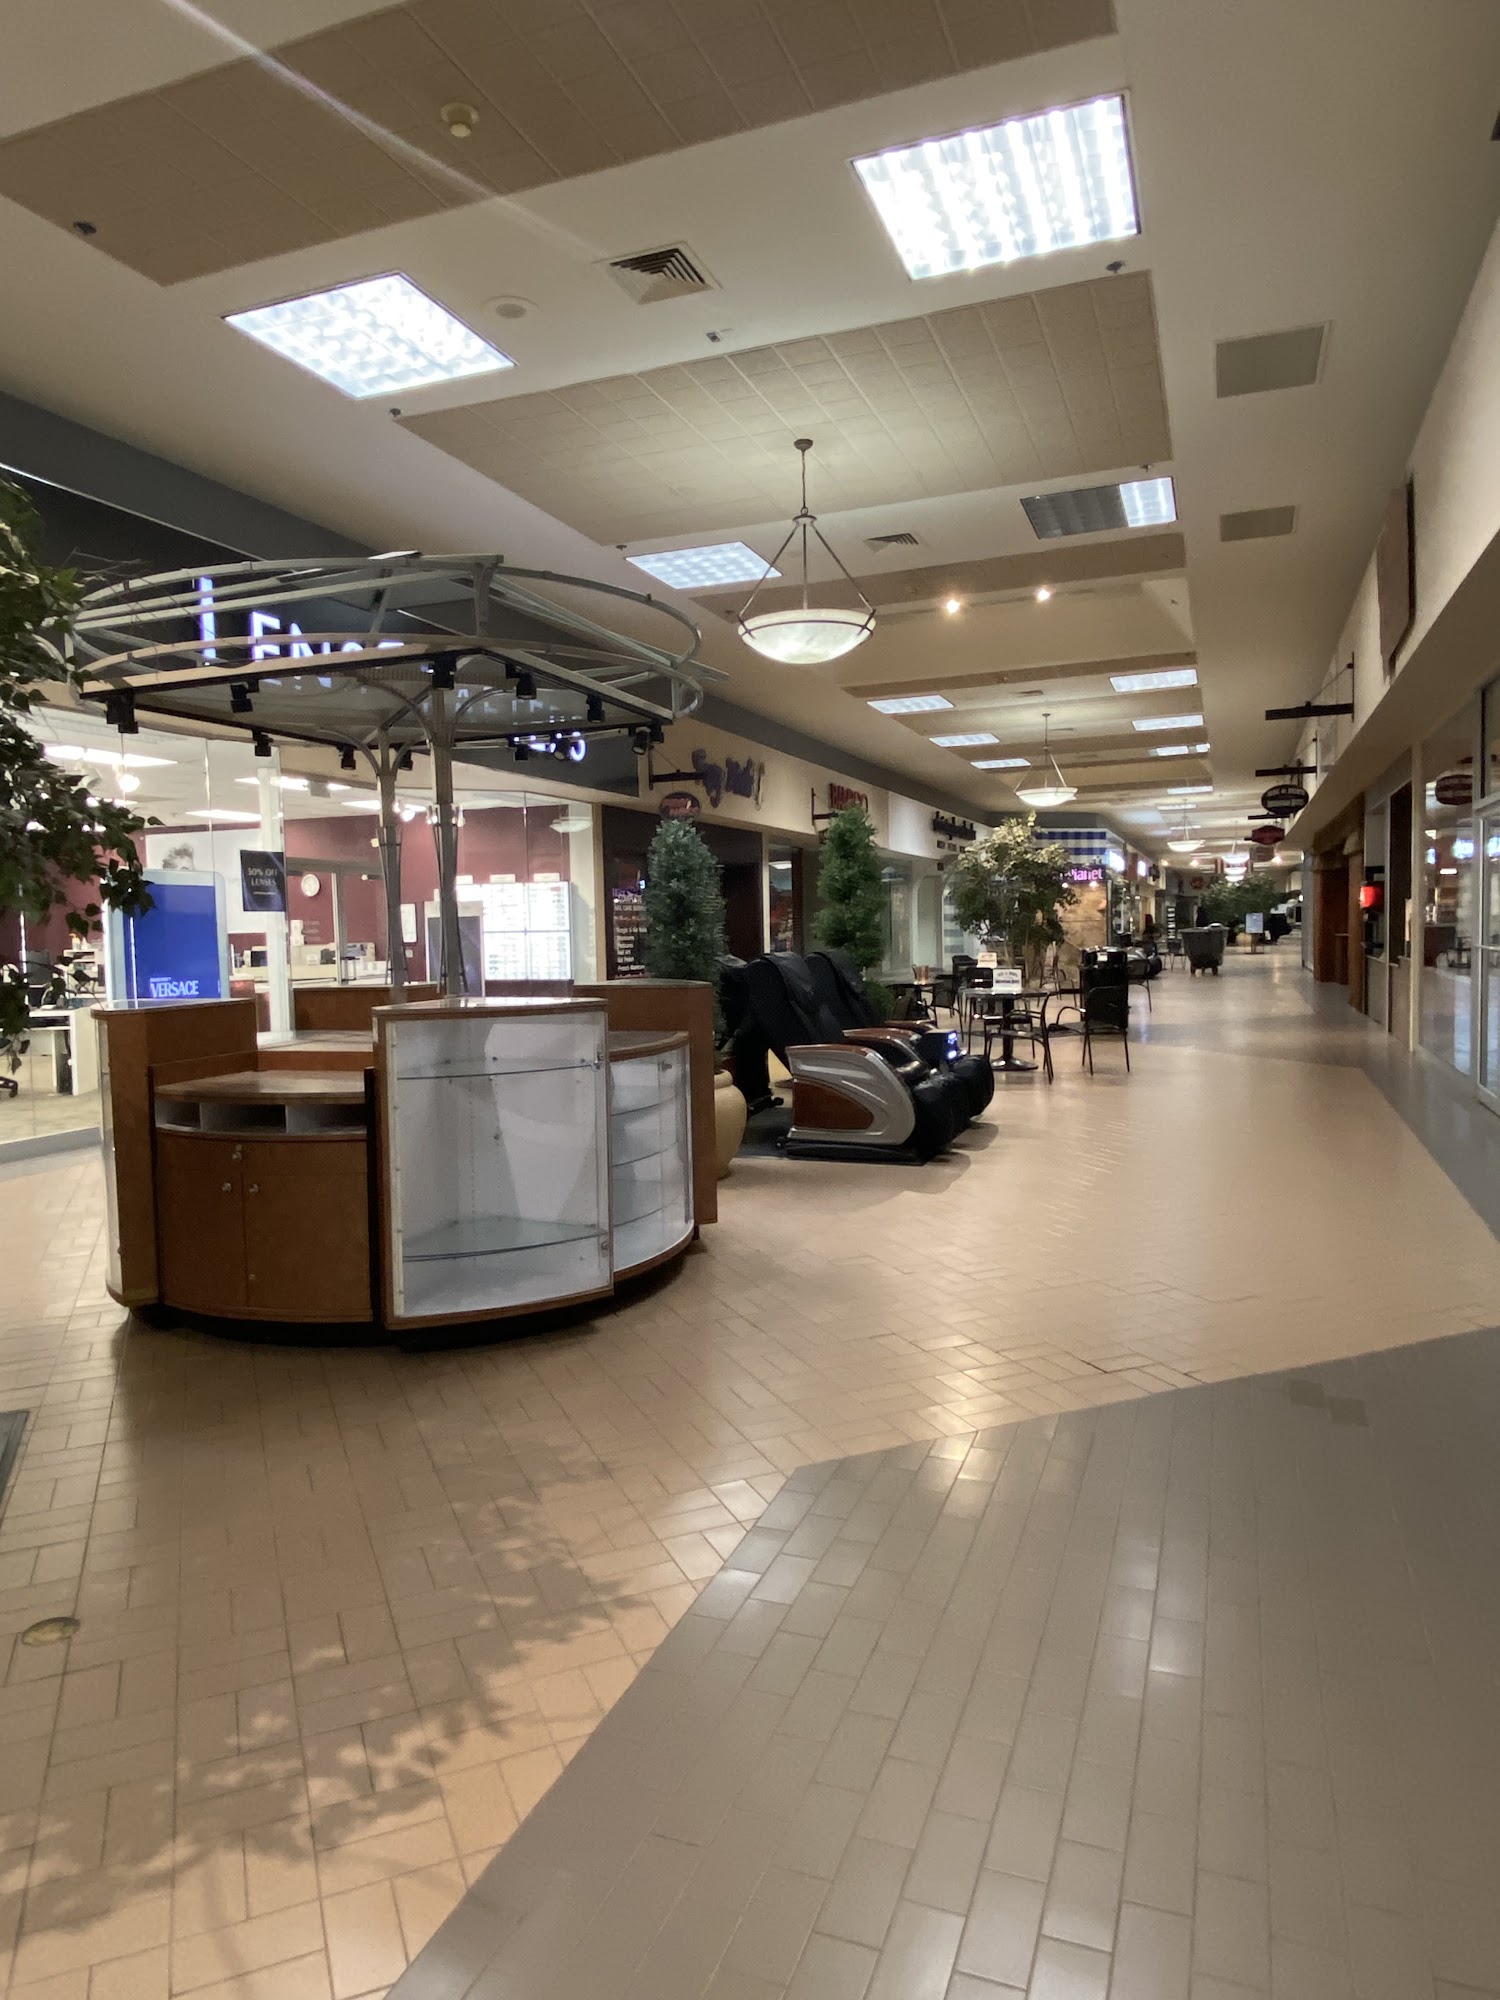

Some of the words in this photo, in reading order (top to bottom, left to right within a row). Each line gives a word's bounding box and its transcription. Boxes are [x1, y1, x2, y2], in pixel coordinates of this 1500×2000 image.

[265, 867, 278, 876] OFF
[251, 877, 276, 886] LENSES
[150, 980, 199, 998] VERSACE
